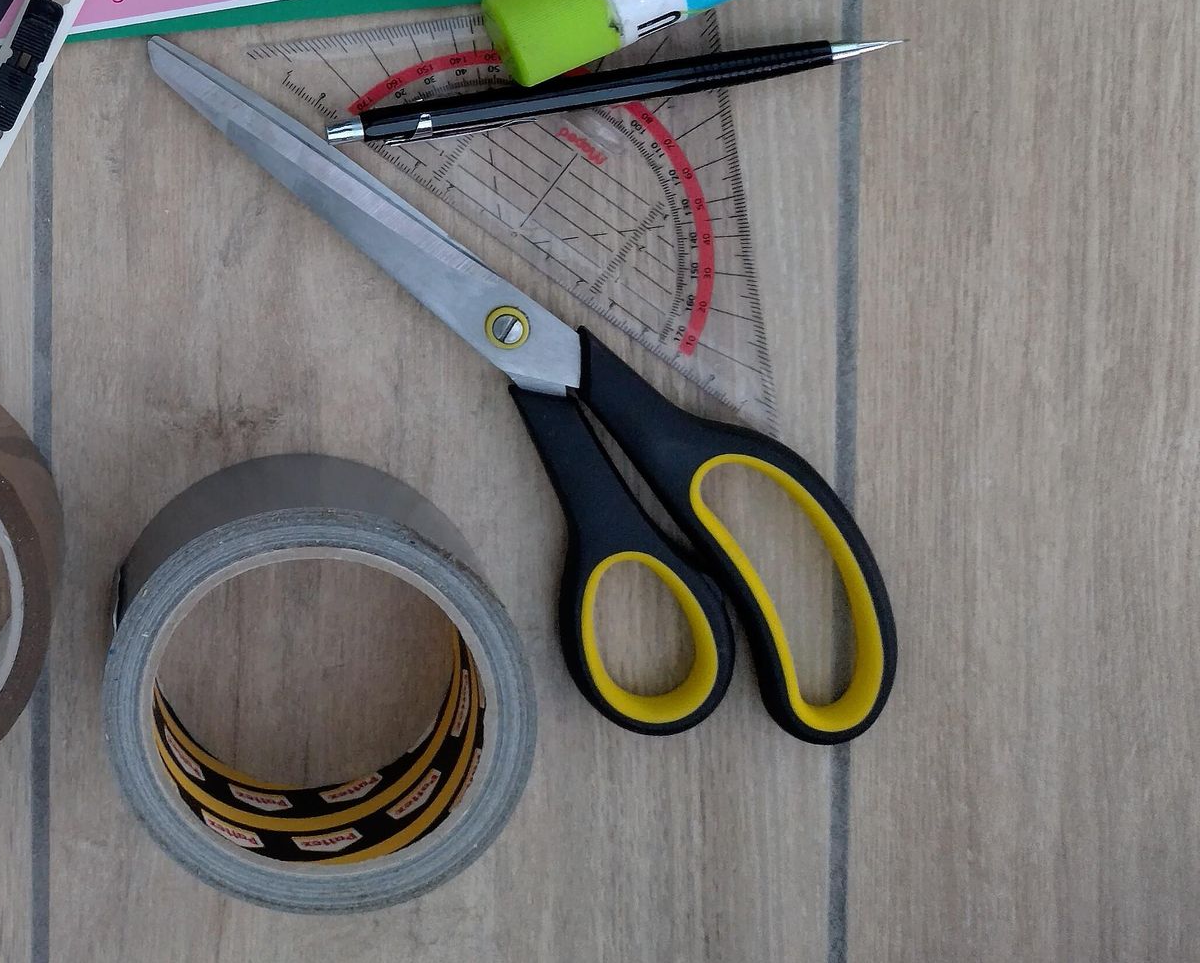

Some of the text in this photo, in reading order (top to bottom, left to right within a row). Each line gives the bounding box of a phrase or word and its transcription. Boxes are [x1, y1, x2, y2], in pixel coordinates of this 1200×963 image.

[417, 64, 434, 76] 150
[449, 56, 467, 66] 140
[394, 65, 501, 99] 20 30 40 50
[301, 832, 358, 847] Pattex
